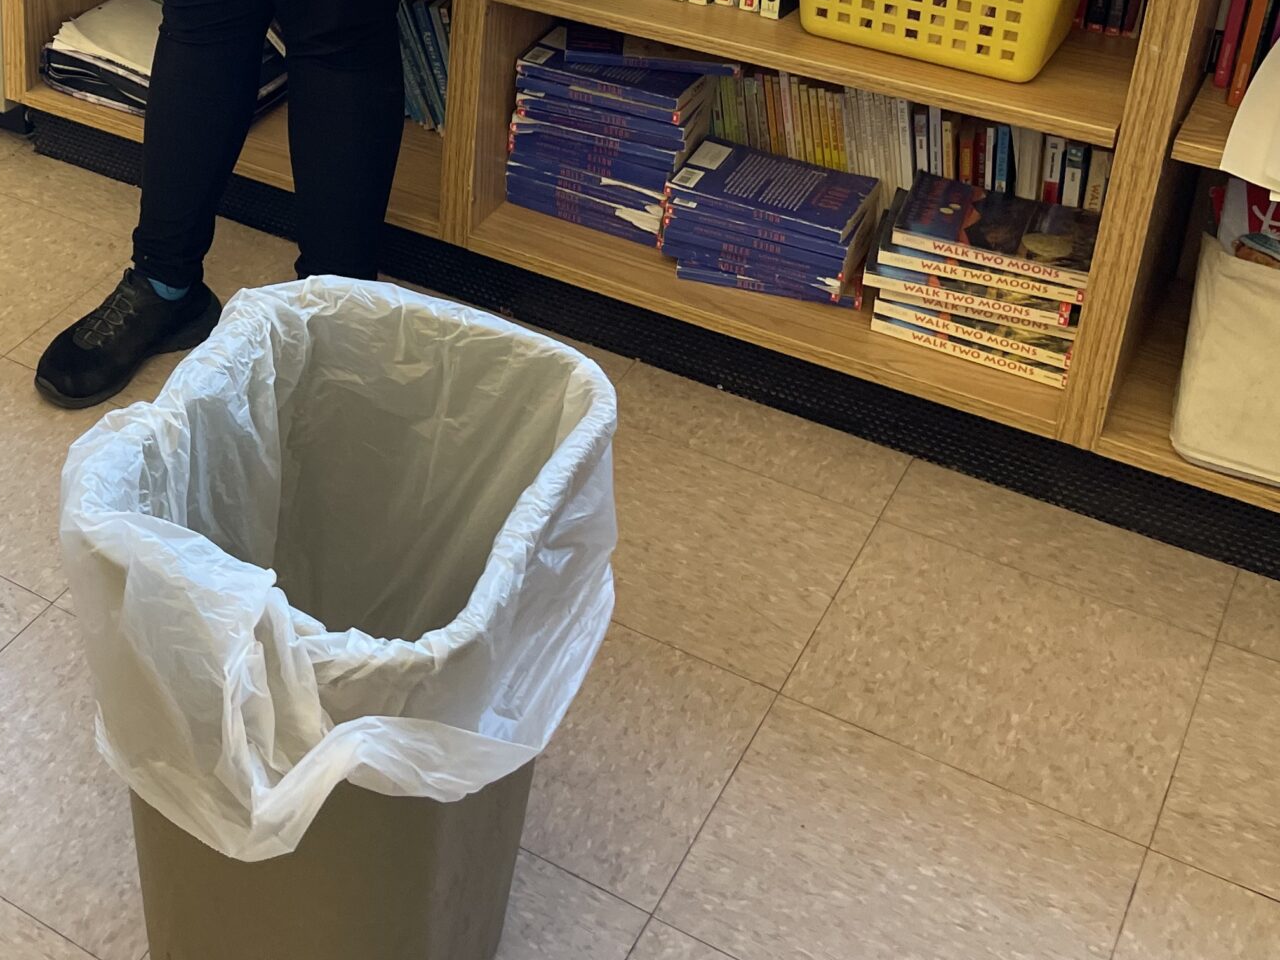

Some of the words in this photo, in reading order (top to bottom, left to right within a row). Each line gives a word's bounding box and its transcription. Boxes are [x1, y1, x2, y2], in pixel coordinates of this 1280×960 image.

[933, 242, 969, 257] WALK
[974, 251, 1004, 265] TWO
[1007, 260, 1060, 278] MOONS
[921, 261, 958, 275] WALK
[963, 270, 993, 282] TWO
[996, 279, 1049, 294] MOONS
[904, 284, 940, 297] WALK
[944, 291, 975, 305] TWO
[978, 300, 1030, 317] MOONS
[923, 298, 959, 311] WALK
[964, 306, 993, 319] TWO
[997, 314, 1049, 331] MOONS
[914, 313, 949, 330] WALK
[954, 326, 983, 340] TWO
[987, 336, 1038, 356] MOONS
[911, 332, 947, 349] WALK
[951, 345, 980, 359] TWO
[984, 356, 1035, 376] MOONS
